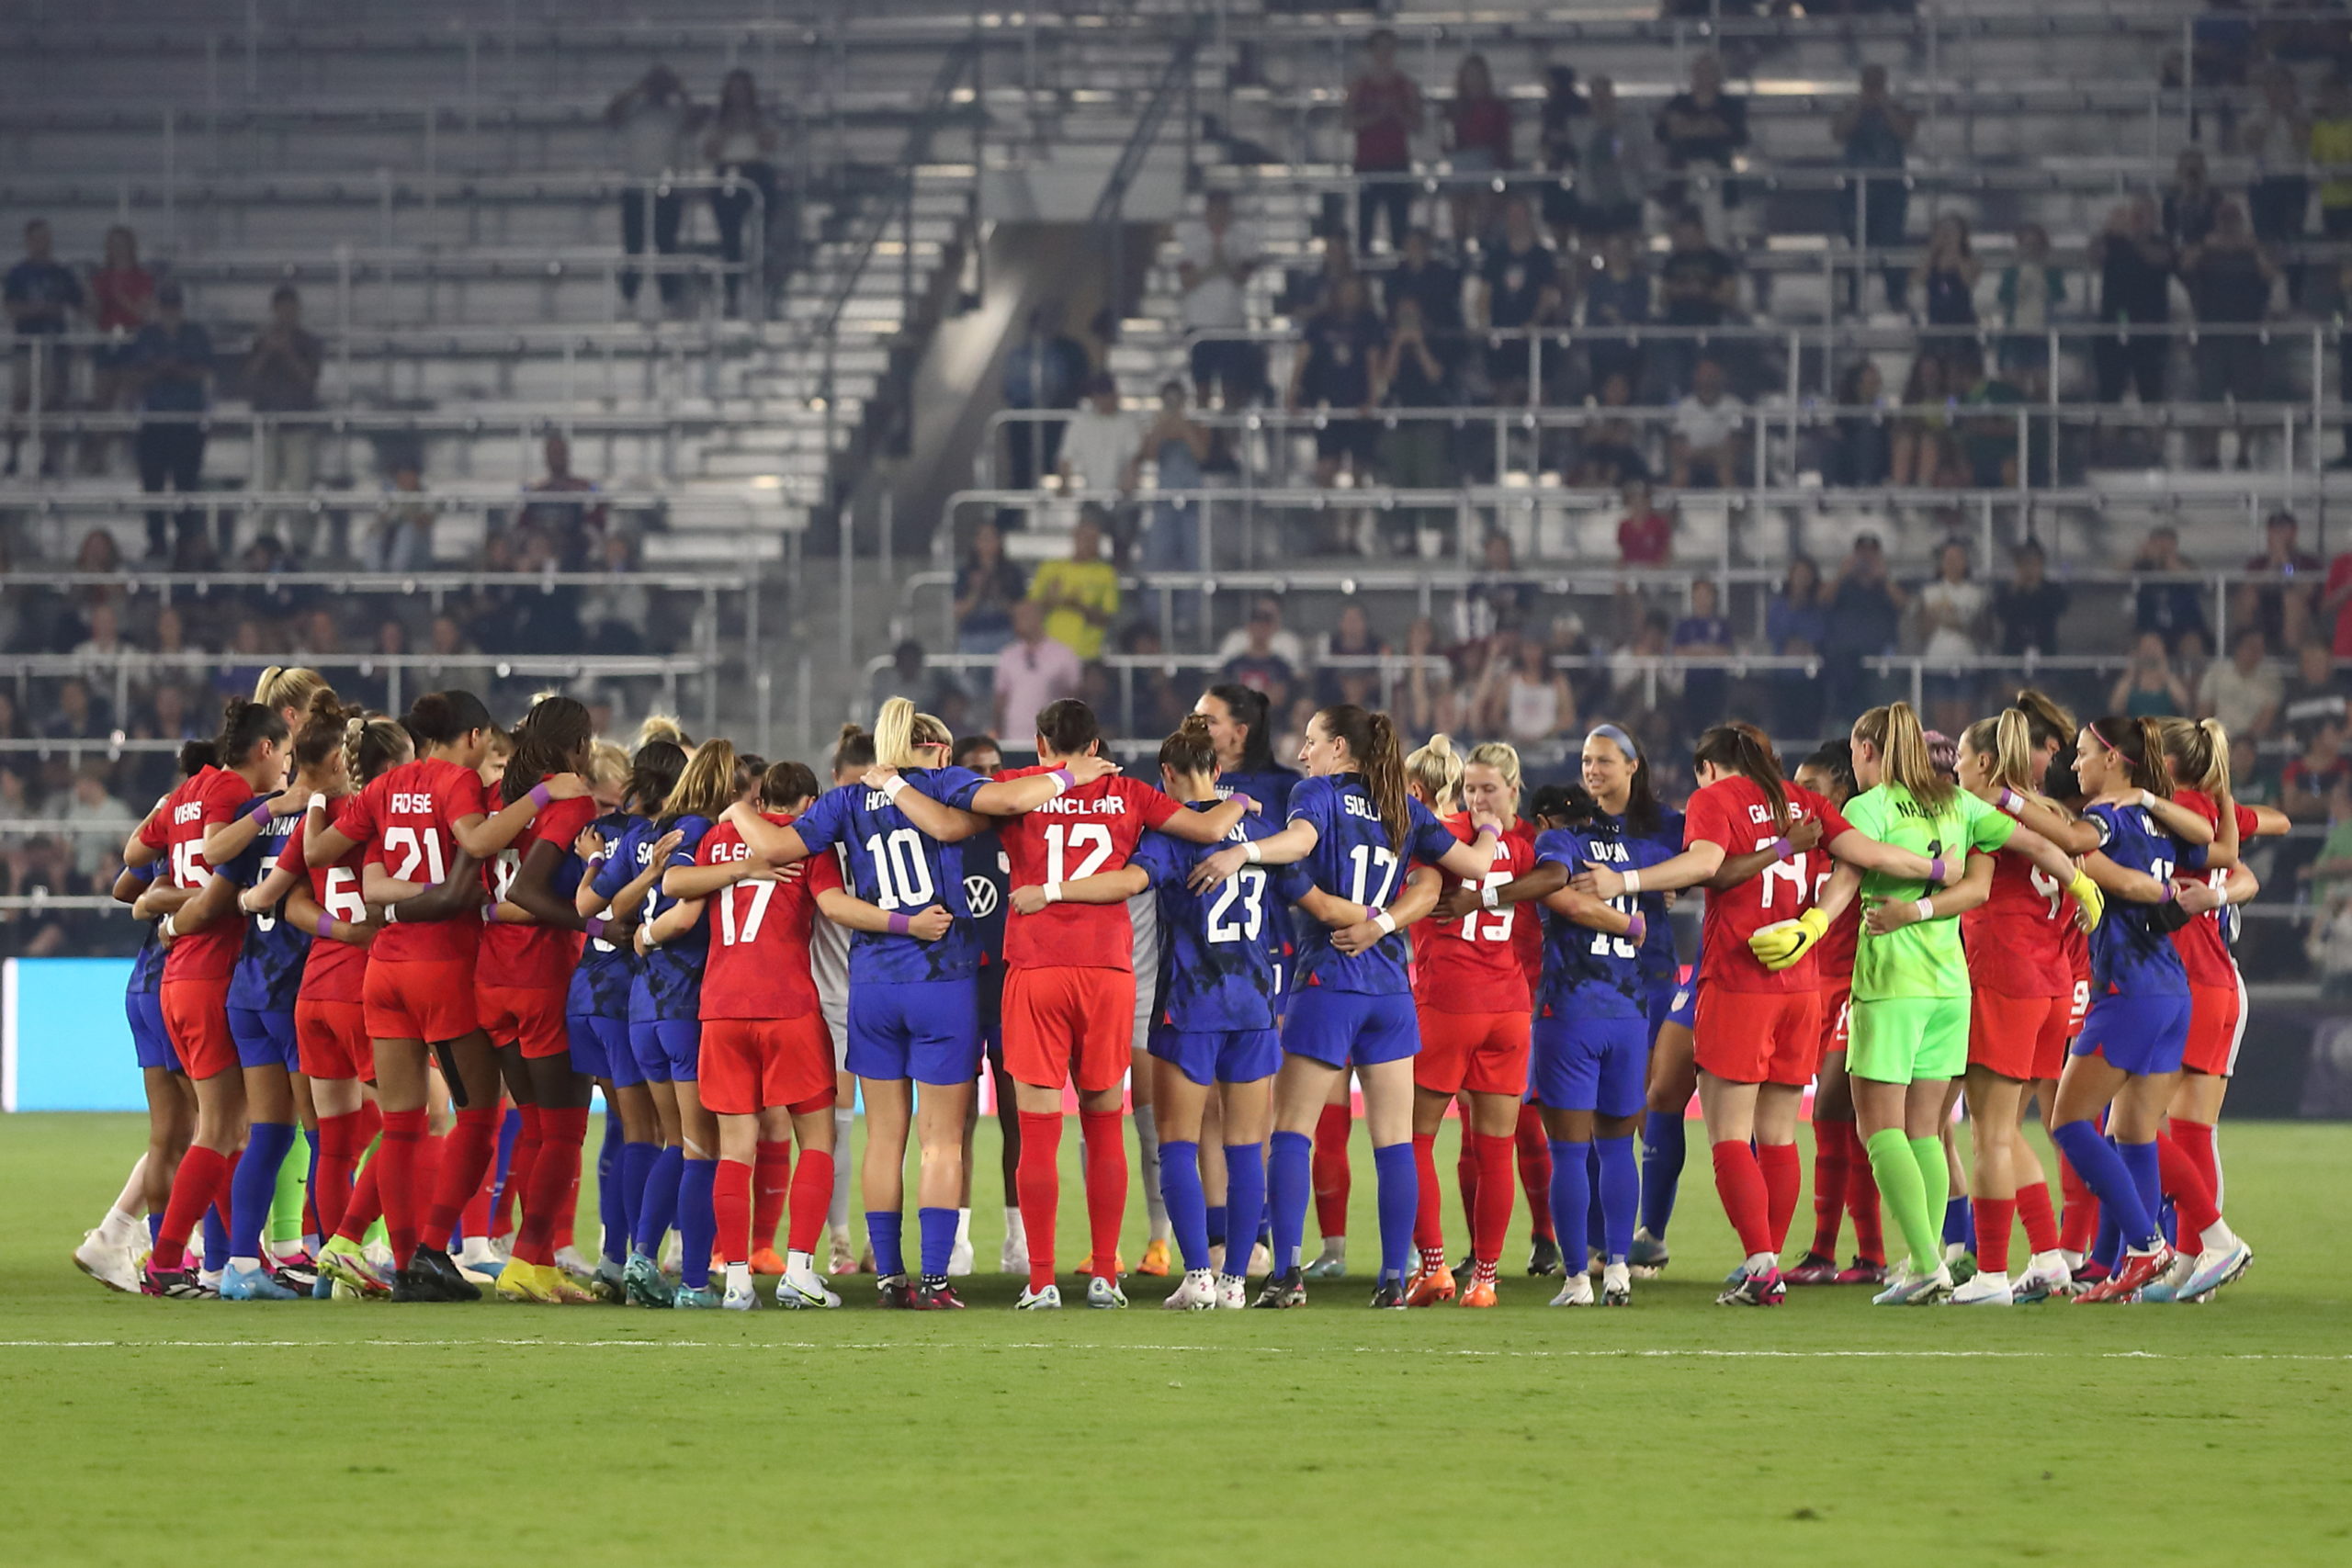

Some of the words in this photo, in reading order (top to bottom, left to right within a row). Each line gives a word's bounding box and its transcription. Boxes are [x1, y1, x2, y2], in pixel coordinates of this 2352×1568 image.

[175, 801, 202, 825] VIENS
[391, 794, 432, 814] ROSE
[172, 838, 215, 890] 15
[384, 827, 446, 884] 21
[866, 828, 934, 910] 10
[1044, 823, 1114, 884] 12
[1350, 843, 1398, 908] 17
[325, 866, 367, 924] 6
[720, 878, 777, 947] 17
[1208, 863, 1267, 943] 23
[2071, 979, 2090, 1015] 9
